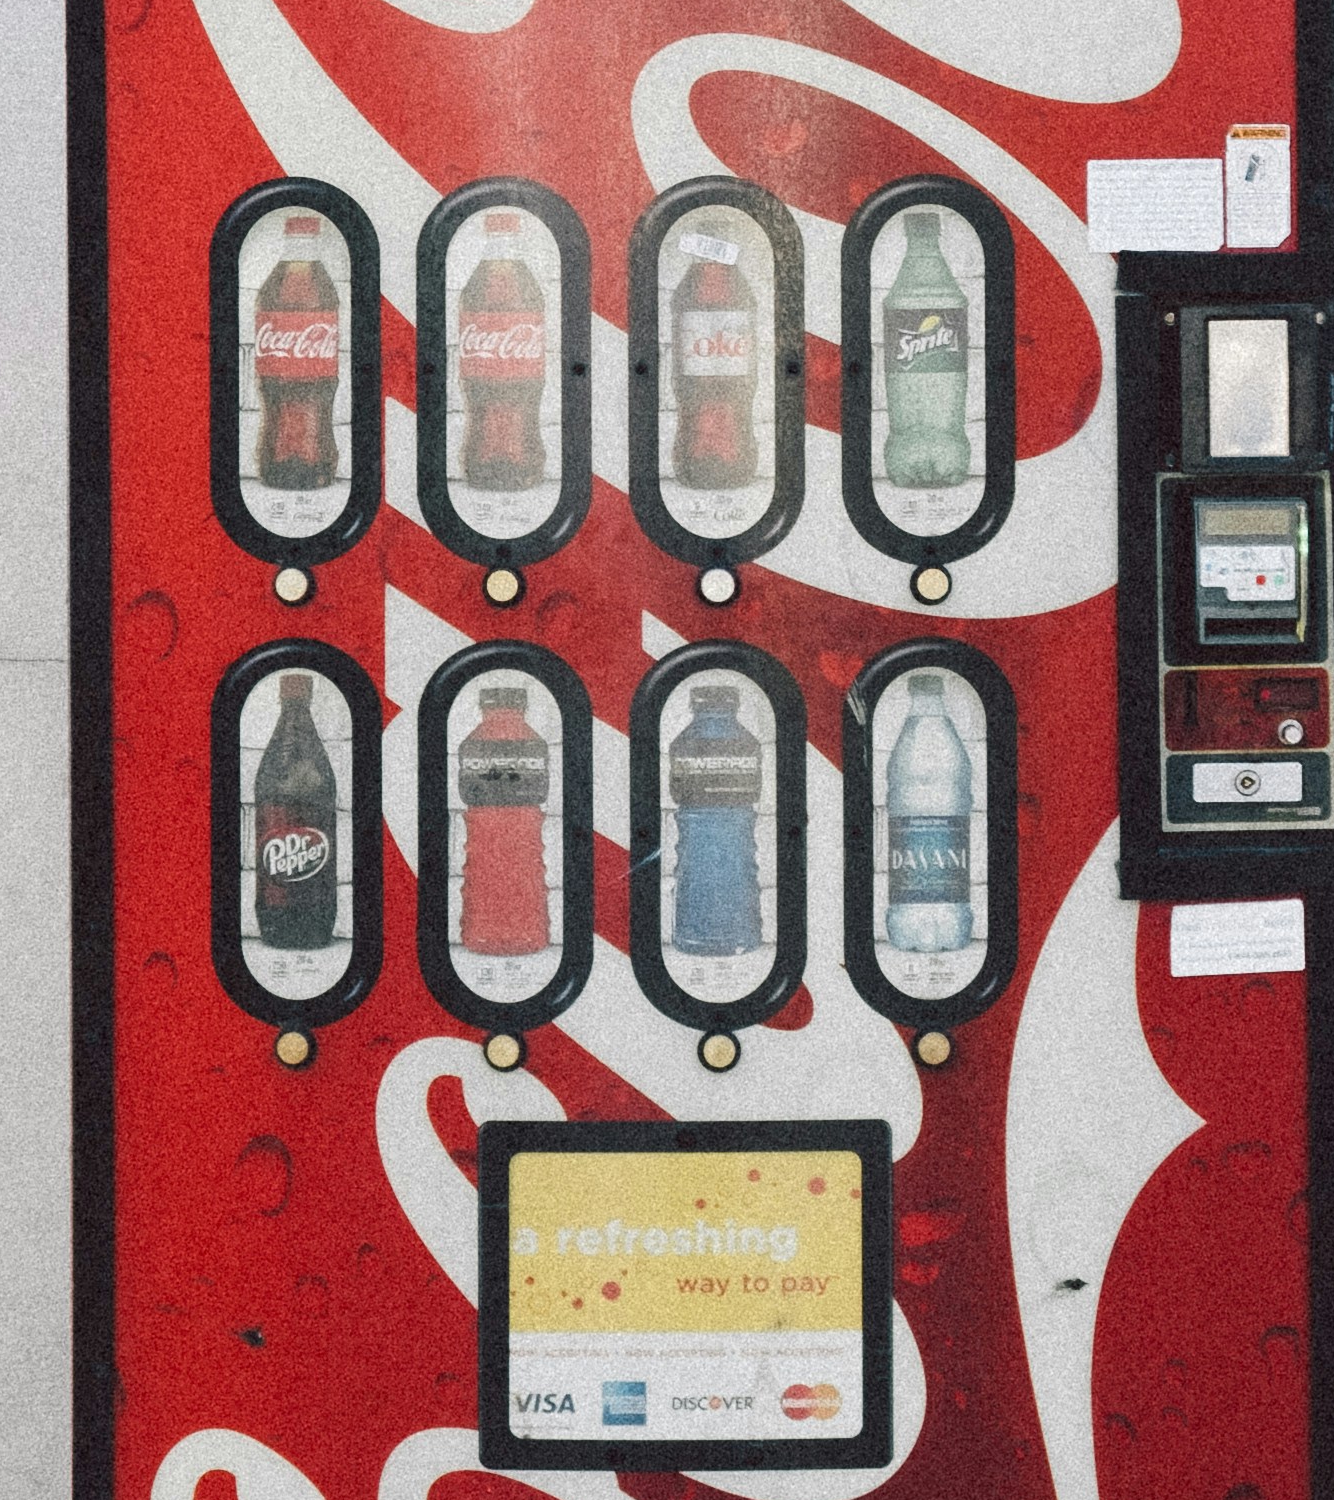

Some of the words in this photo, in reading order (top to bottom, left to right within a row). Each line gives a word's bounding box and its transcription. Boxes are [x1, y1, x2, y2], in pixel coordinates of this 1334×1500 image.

[684, 330, 751, 358] oke
[896, 325, 955, 362] Sprite
[264, 838, 325, 876] Pepper
[285, 833, 312, 856] Dr
[512, 1226, 539, 1256] a
[556, 1219, 798, 1263] refreshing
[676, 1275, 731, 1297] way
[742, 1273, 770, 1294] to
[780, 1276, 831, 1297] pay
[514, 1392, 576, 1414] VISA
[672, 1394, 754, 1412] DISCOVER
